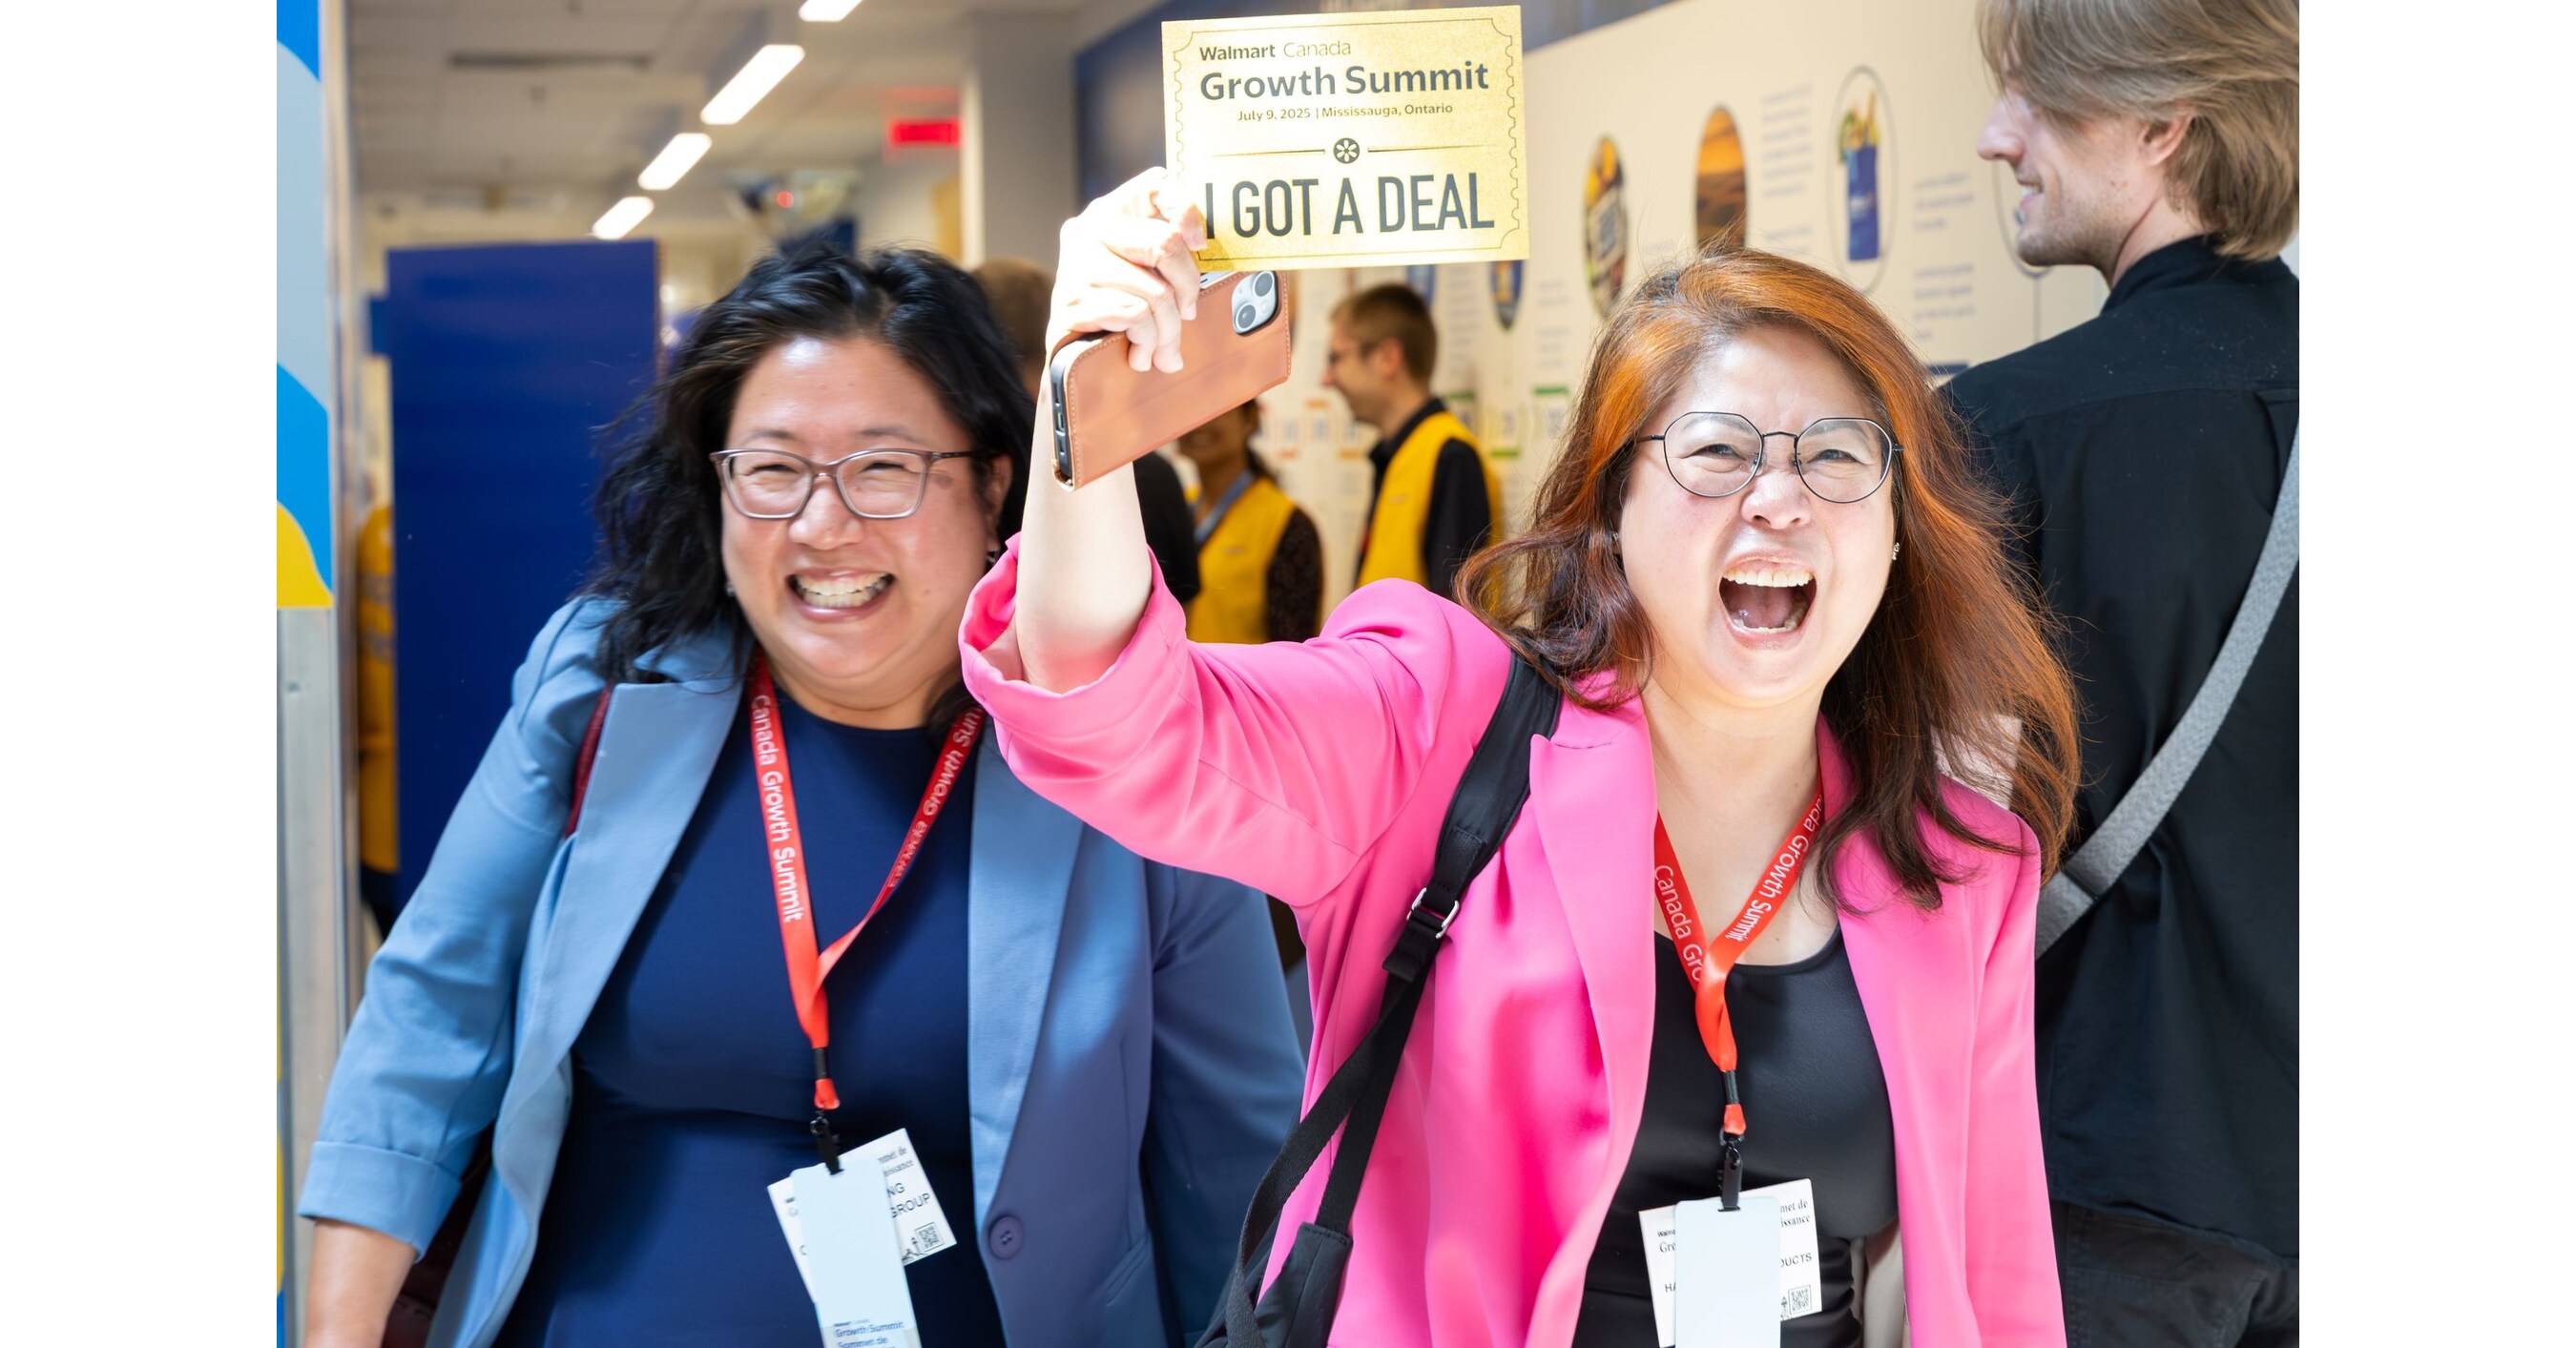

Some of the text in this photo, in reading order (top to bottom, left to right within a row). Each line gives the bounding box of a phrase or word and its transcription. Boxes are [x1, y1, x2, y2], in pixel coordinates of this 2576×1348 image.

[1199, 40, 1351, 61] Walmart Canada
[1200, 61, 1489, 100] Growth Summit
[1237, 110, 1263, 122] July
[1266, 109, 1278, 120] 9,
[1280, 108, 1311, 119] 2025
[1322, 105, 1402, 118] Mississauga,
[1404, 103, 1453, 114] Ontario
[1205, 173, 1495, 239] I GOT A DEAL
[923, 750, 965, 816] Growth
[751, 695, 804, 923] Canada Growth Summit
[1758, 834, 1810, 899] Growth
[1654, 864, 1703, 982] Canada Gro
[1725, 899, 1773, 943] Summit
[1780, 1214, 1811, 1228] issance
[1797, 1198, 1809, 1210] de
